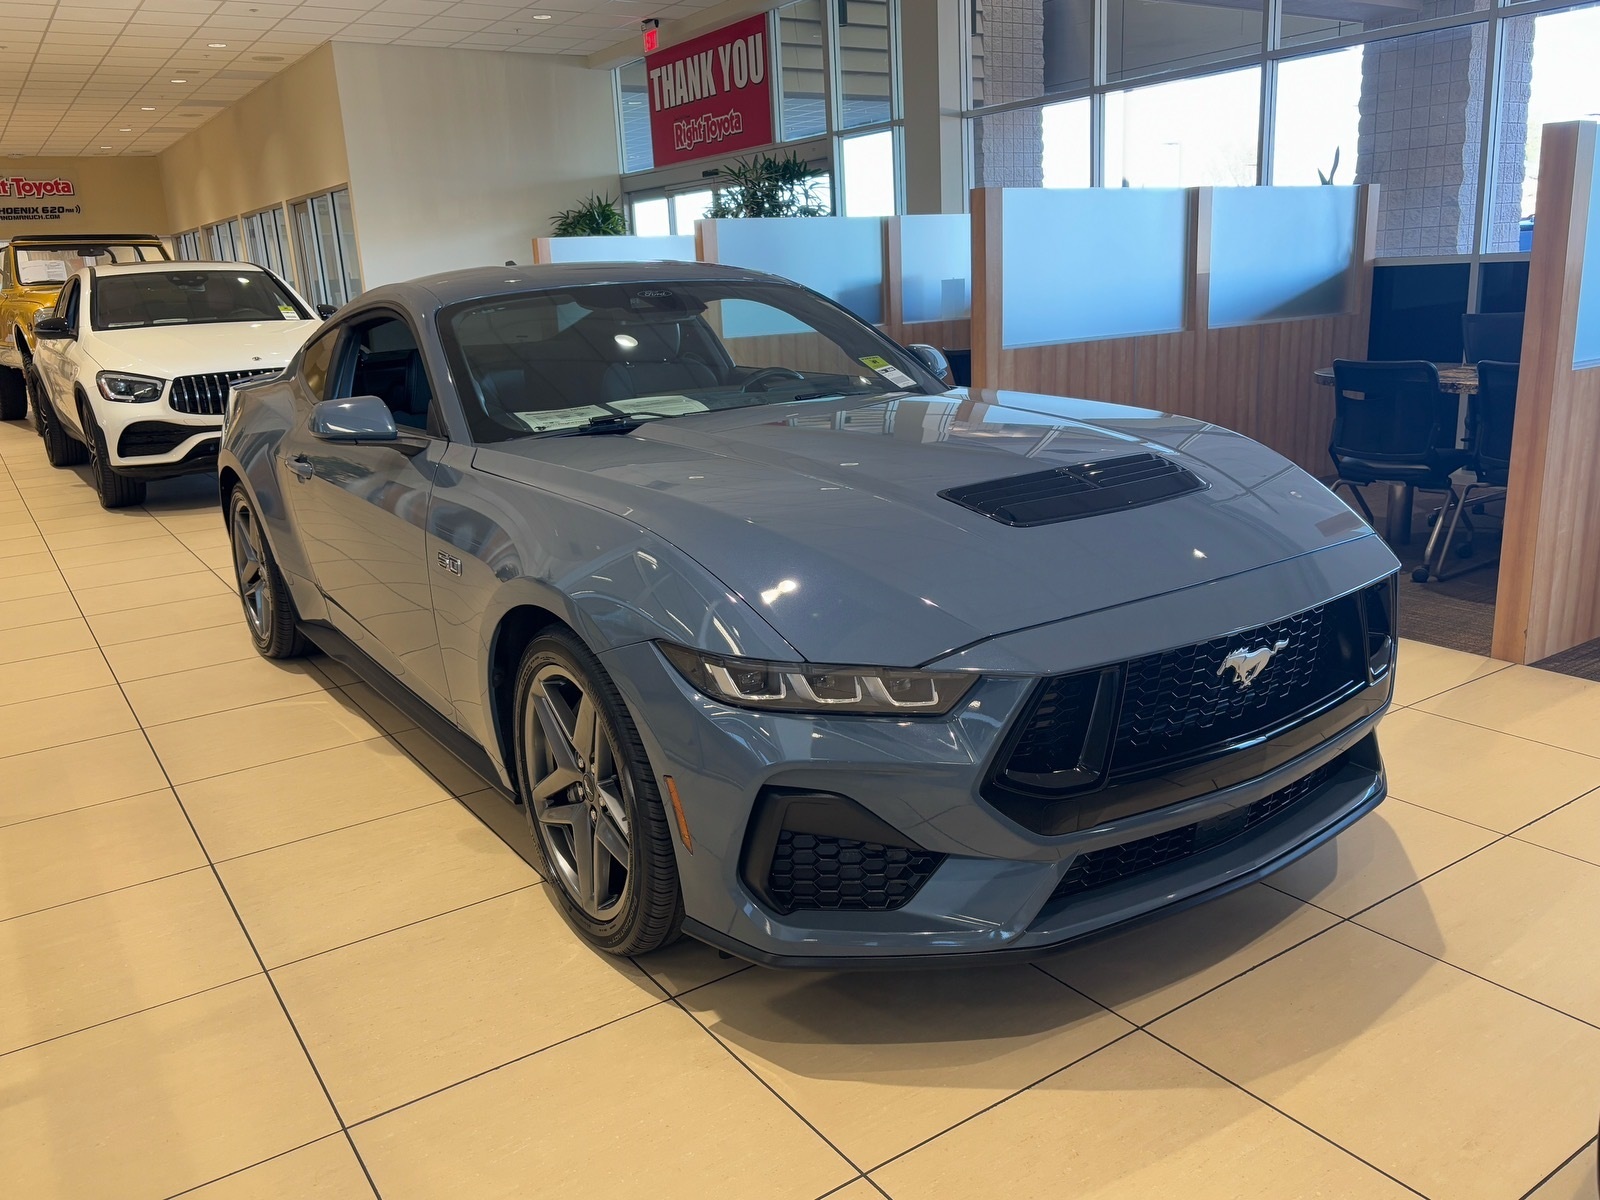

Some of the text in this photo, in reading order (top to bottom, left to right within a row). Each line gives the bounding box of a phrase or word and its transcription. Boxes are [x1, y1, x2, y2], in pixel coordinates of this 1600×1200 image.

[650, 33, 765, 112] THANK YOU
[673, 108, 743, 151] Right Toyota
[10, 177, 74, 198] Toyota
[0, 206, 39, 215] HOENIX
[42, 206, 65, 214] 620
